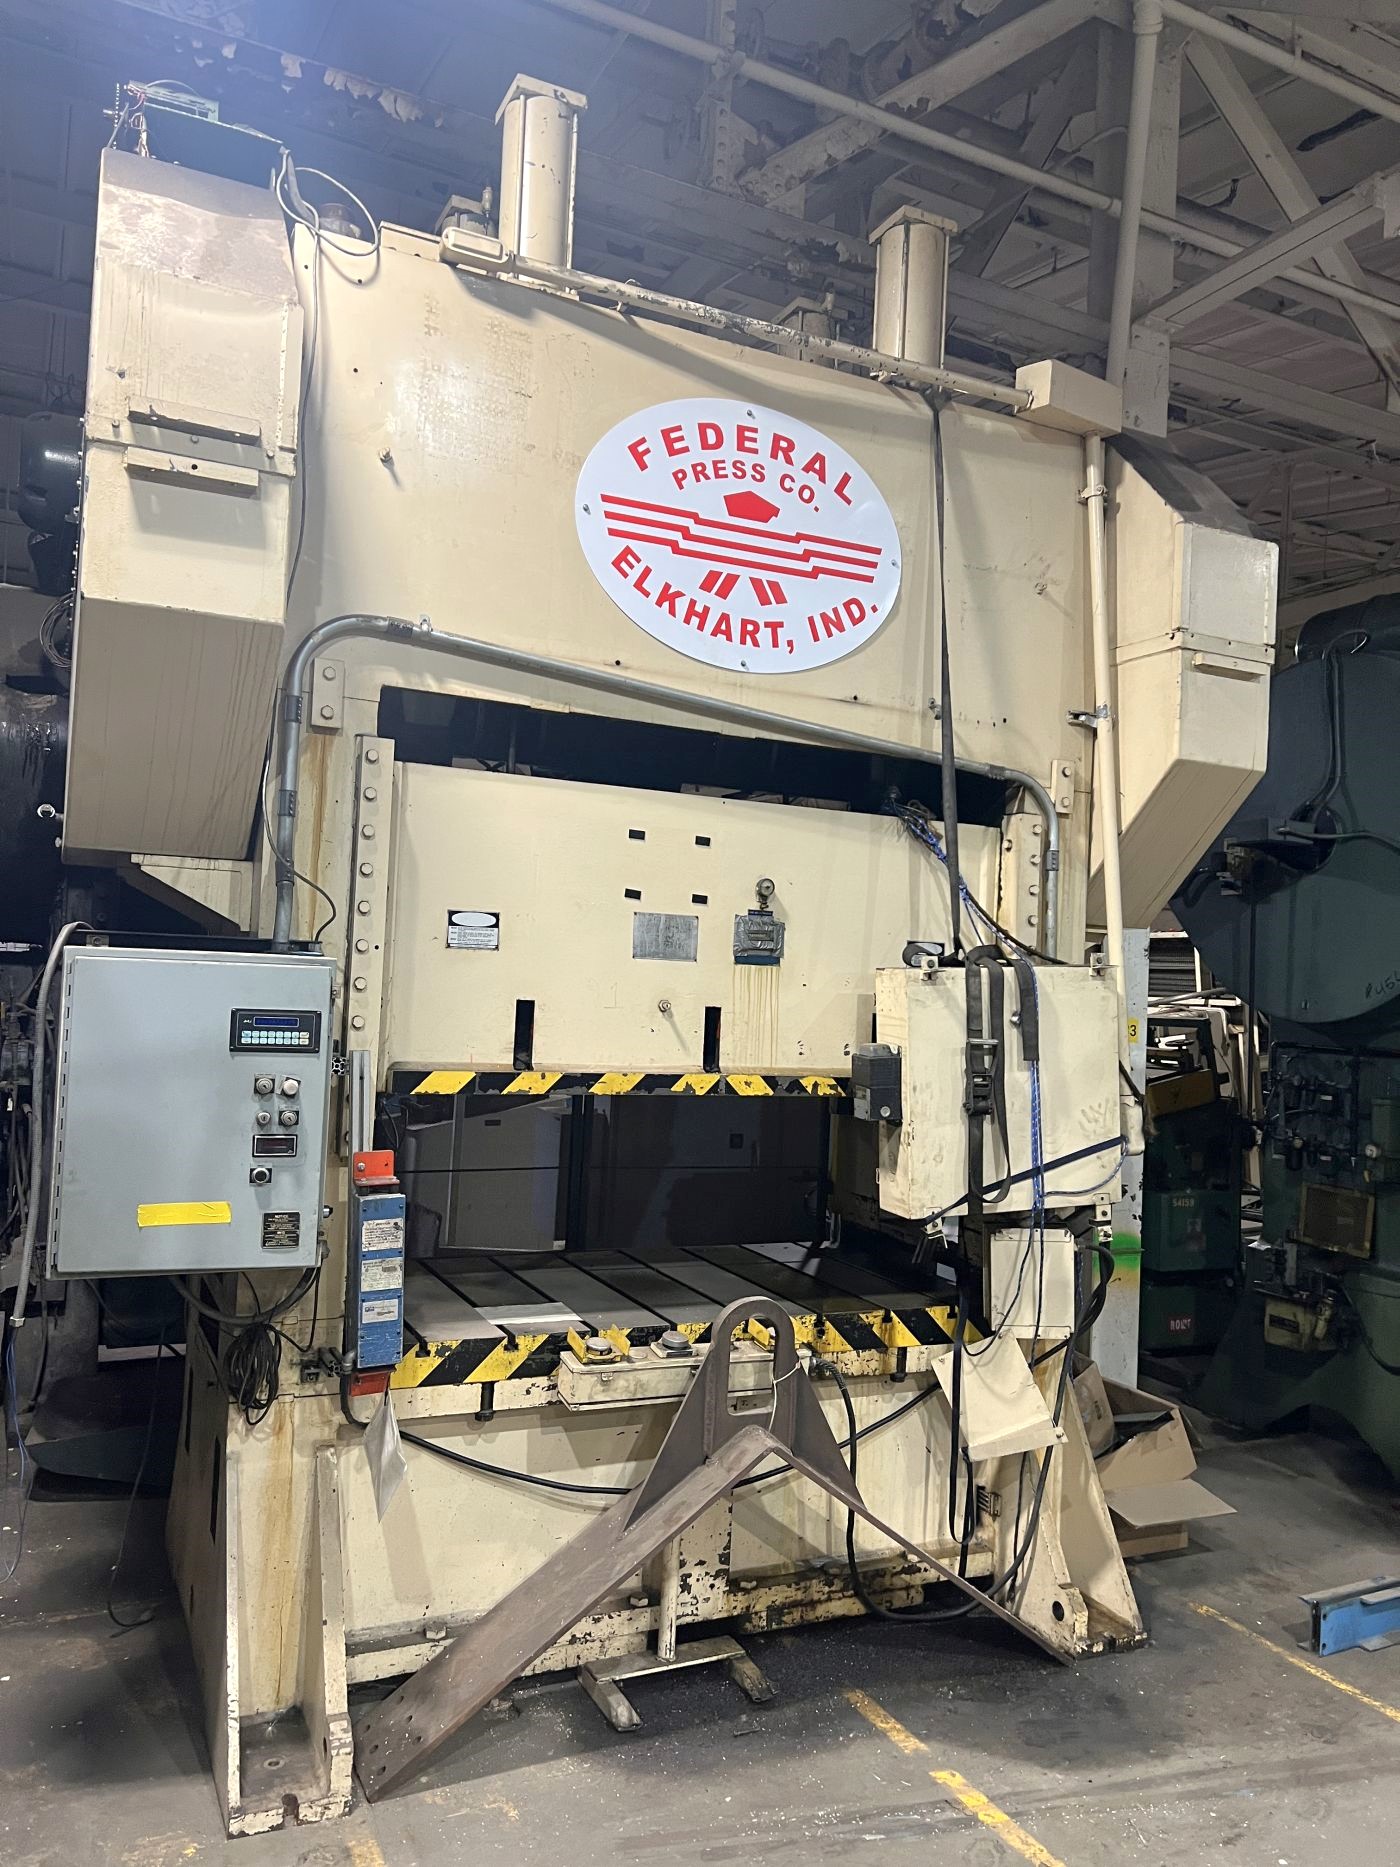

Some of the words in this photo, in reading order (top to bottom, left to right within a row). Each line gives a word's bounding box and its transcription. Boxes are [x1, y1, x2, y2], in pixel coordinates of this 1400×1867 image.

[627, 422, 853, 505] FEDERAL
[672, 459, 766, 490] PRESS
[779, 473, 820, 513] CO.
[611, 545, 794, 654] ELKHART,
[807, 596, 879, 644] IND.
